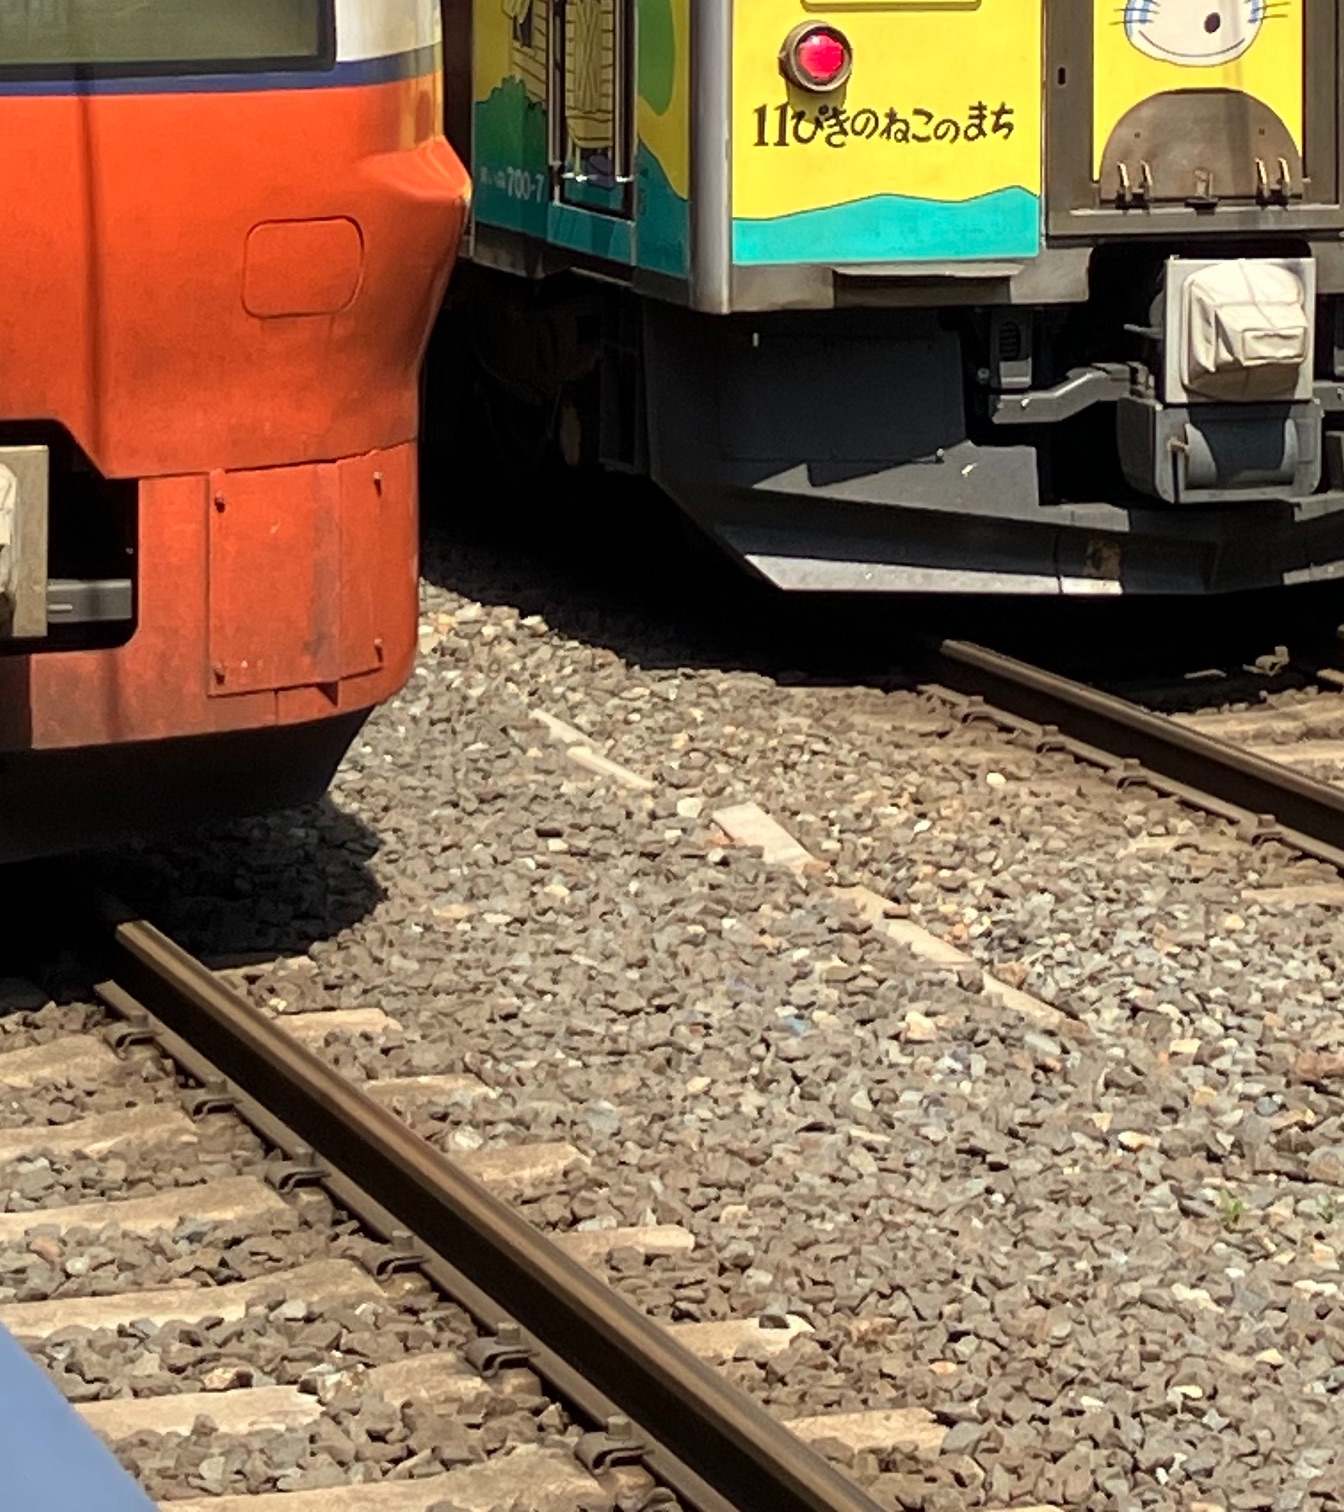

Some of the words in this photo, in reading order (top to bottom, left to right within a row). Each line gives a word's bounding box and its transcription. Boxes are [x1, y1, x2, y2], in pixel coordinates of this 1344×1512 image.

[752, 100, 1015, 148] 11ぴきのねこのまち
